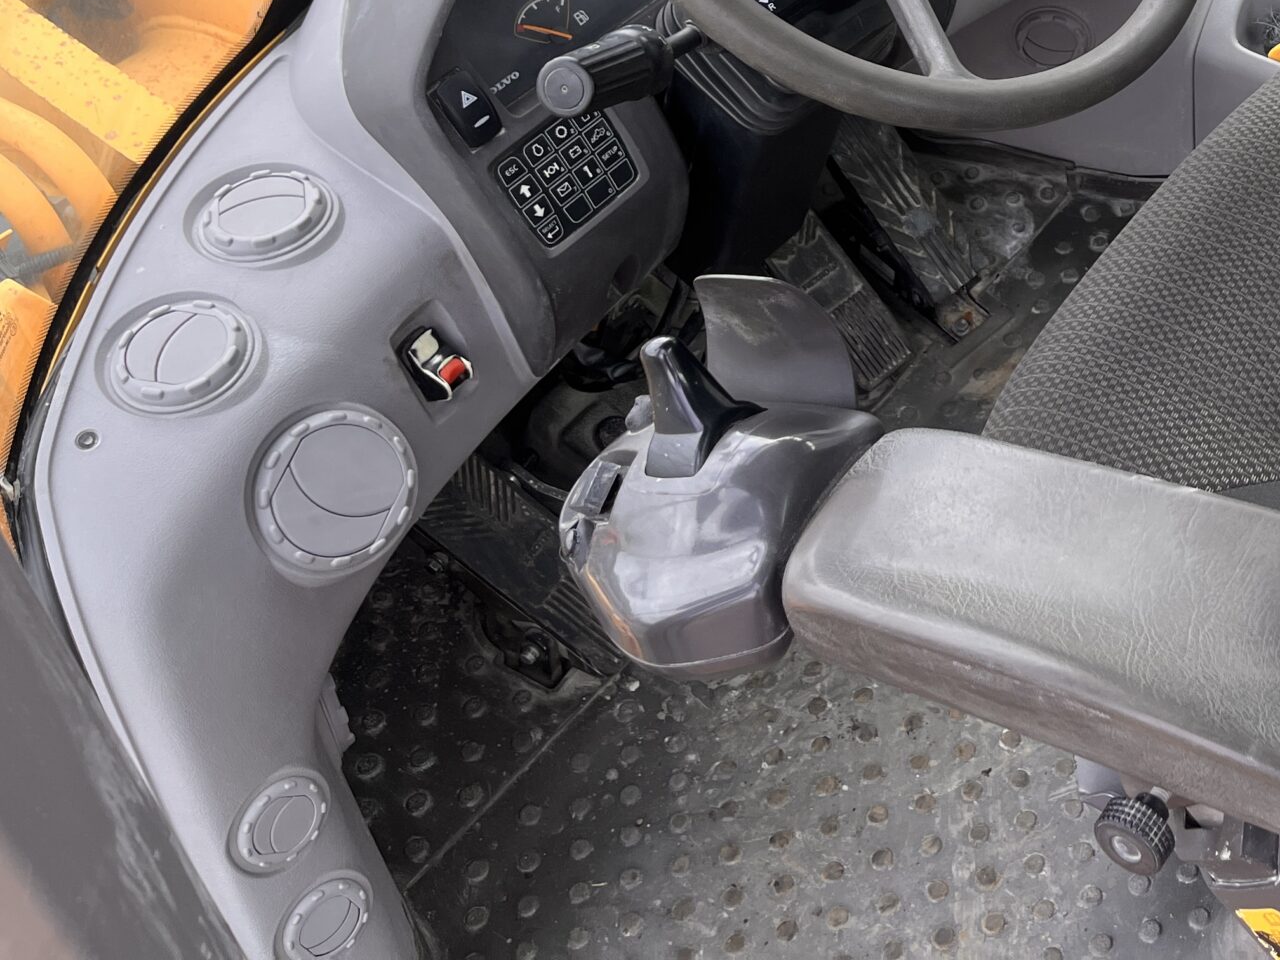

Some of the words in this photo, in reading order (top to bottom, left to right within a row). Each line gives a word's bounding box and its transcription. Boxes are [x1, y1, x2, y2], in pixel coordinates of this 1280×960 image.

[767, 2, 777, 12] R
[488, 70, 520, 96] OLVO
[601, 145, 618, 161] SETUP
[504, 163, 519, 177] ESC
